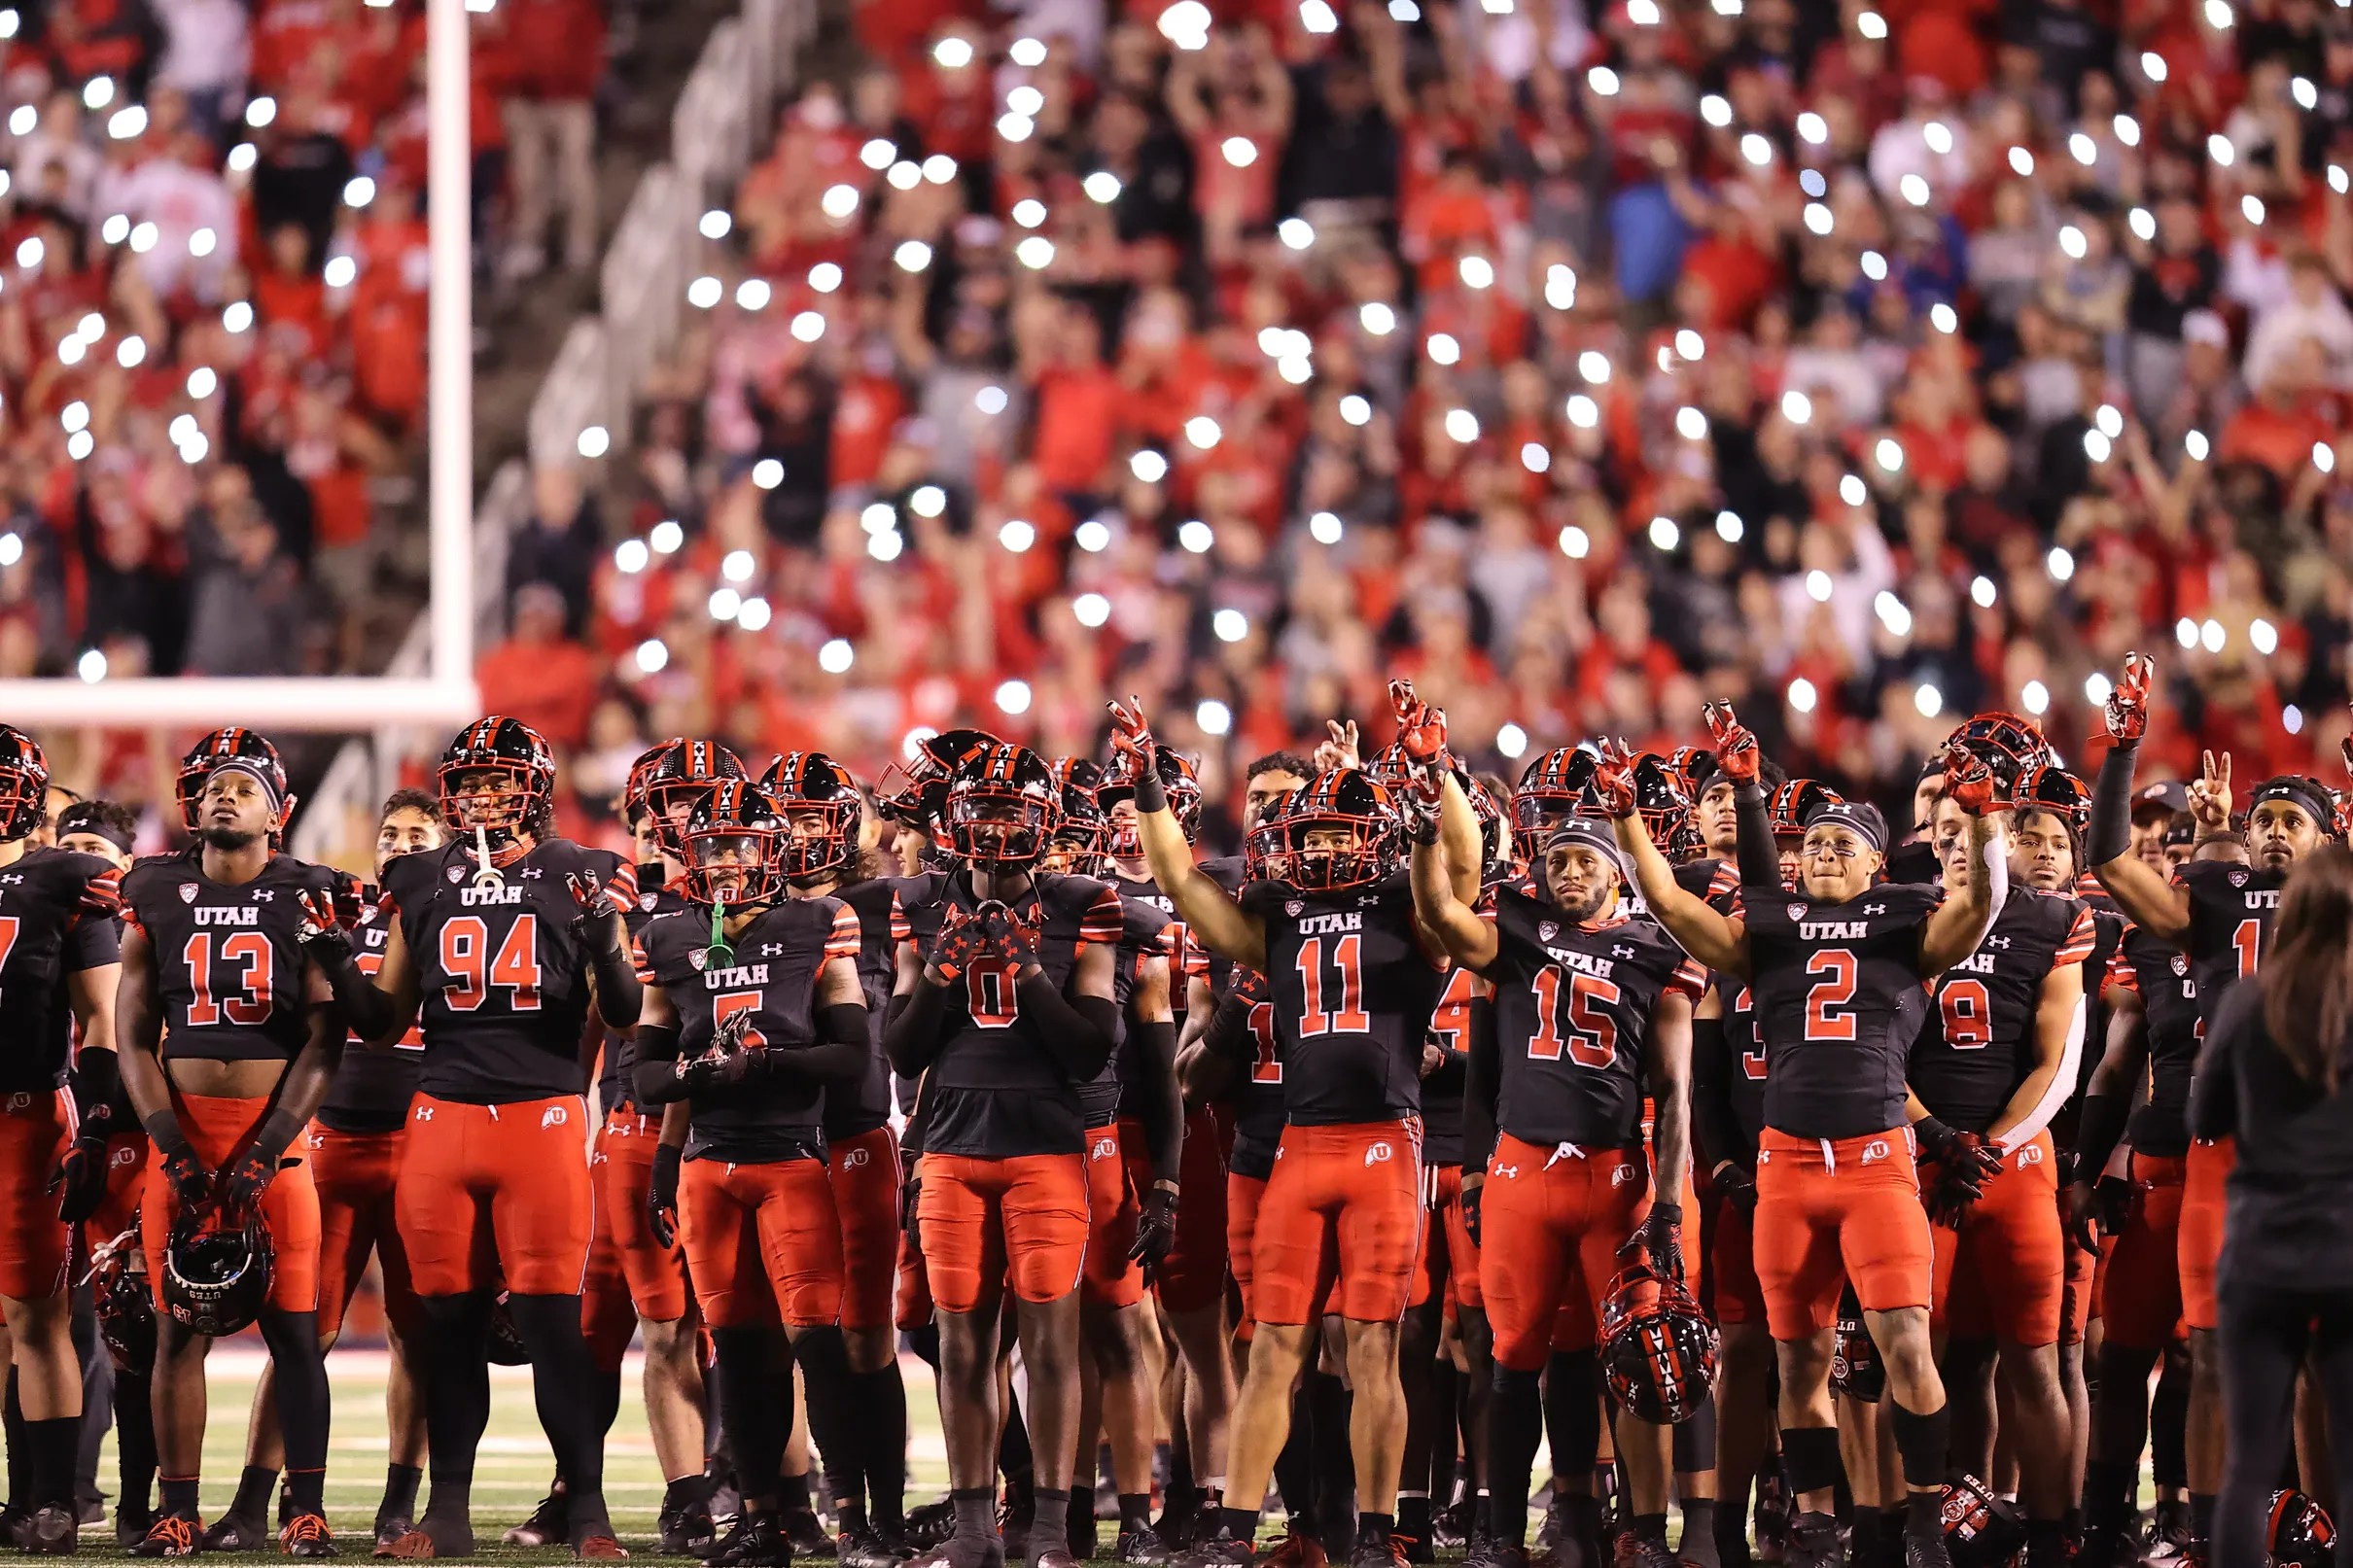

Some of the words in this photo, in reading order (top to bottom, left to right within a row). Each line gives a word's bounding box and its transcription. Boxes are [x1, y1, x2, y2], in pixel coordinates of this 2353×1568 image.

[2244, 889, 2280, 910] UT
[193, 906, 259, 925] UTAH
[1298, 911, 1363, 935] UTAH
[1799, 922, 1868, 940] UTAH
[439, 914, 542, 1011] 94
[704, 964, 769, 990] UTAH
[1547, 947, 1614, 978] UTAH
[183, 931, 273, 1027] 13
[966, 955, 1020, 1028] 0
[1295, 934, 1369, 1039] 11
[1805, 949, 1858, 1041] 2
[1528, 964, 1621, 1070] 15
[1939, 979, 1992, 1050] 8
[1838, 1321, 1856, 1332] UT
[1963, 1474, 1995, 1502] UTES
